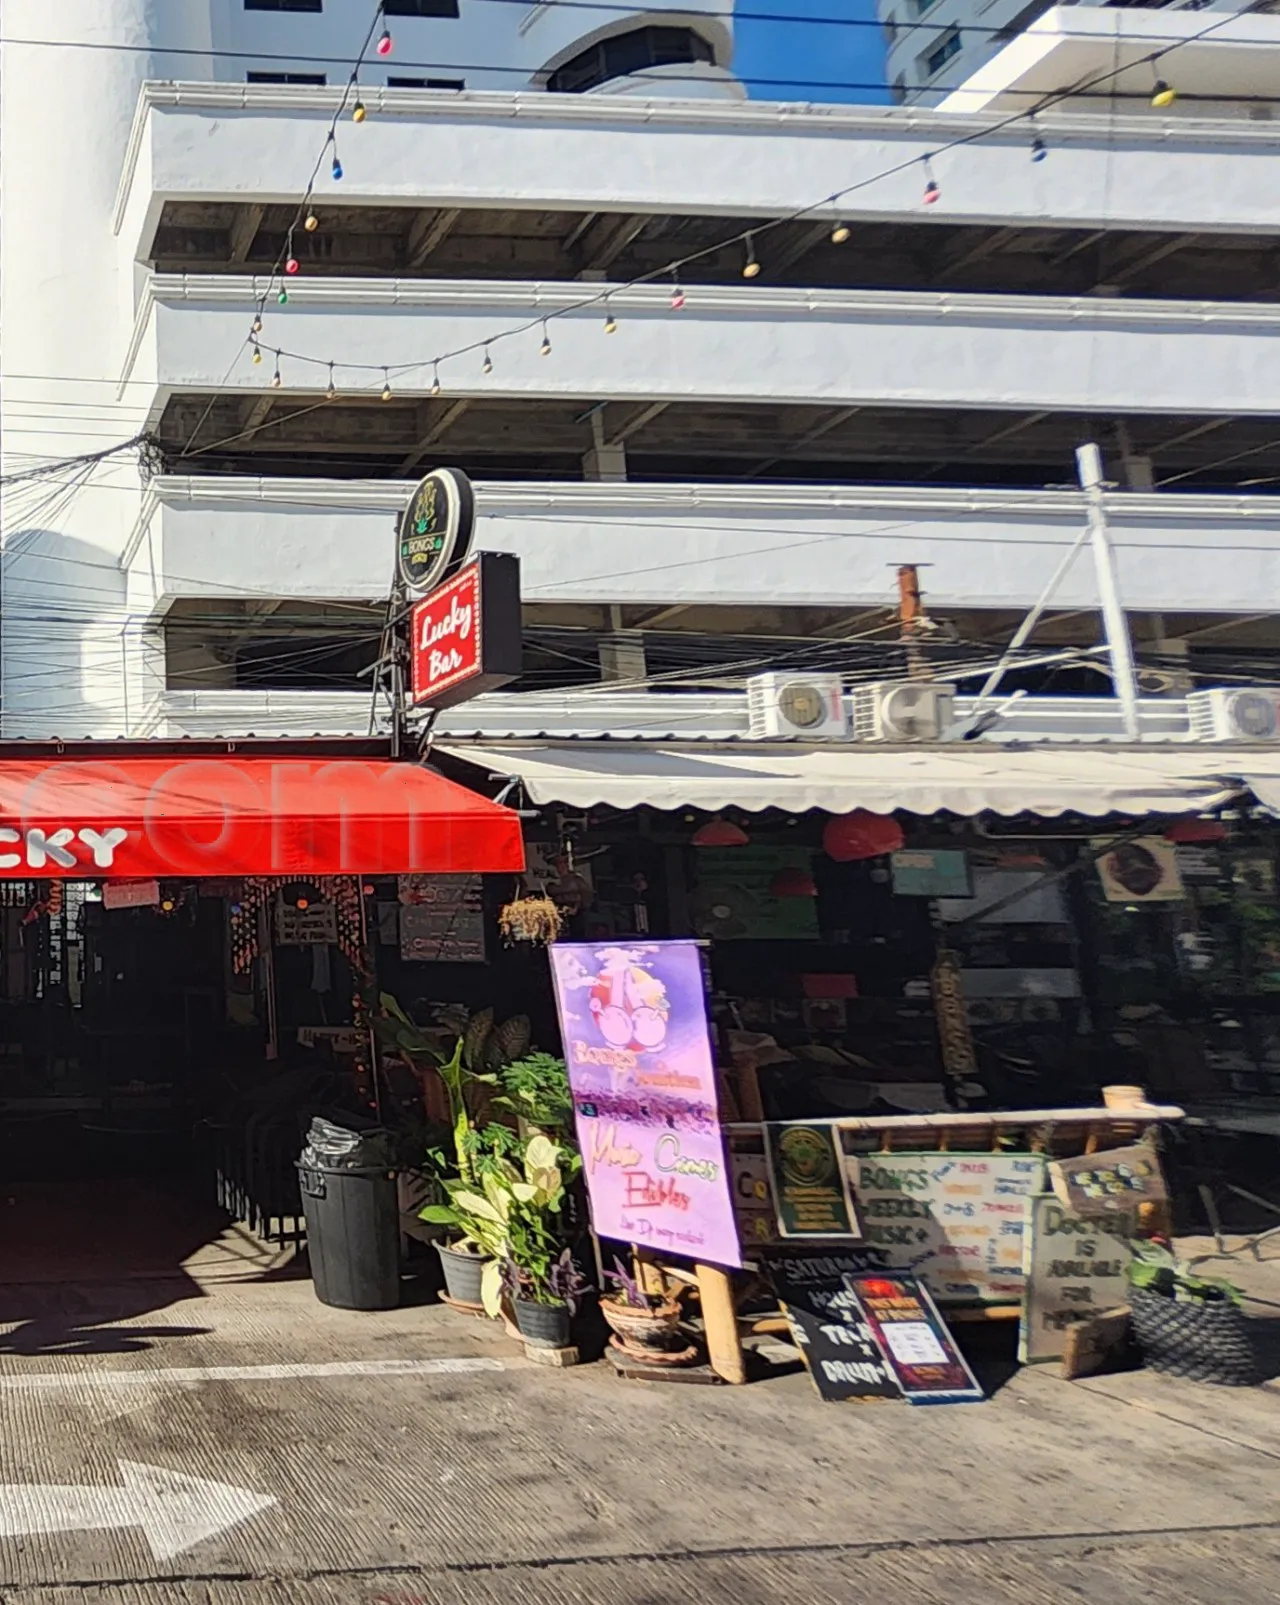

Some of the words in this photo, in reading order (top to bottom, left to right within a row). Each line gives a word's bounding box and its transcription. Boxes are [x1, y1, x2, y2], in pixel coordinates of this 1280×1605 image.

[408, 536, 435, 555] BONGS
[420, 595, 472, 650] Lucky
[427, 648, 463, 682] Bar
